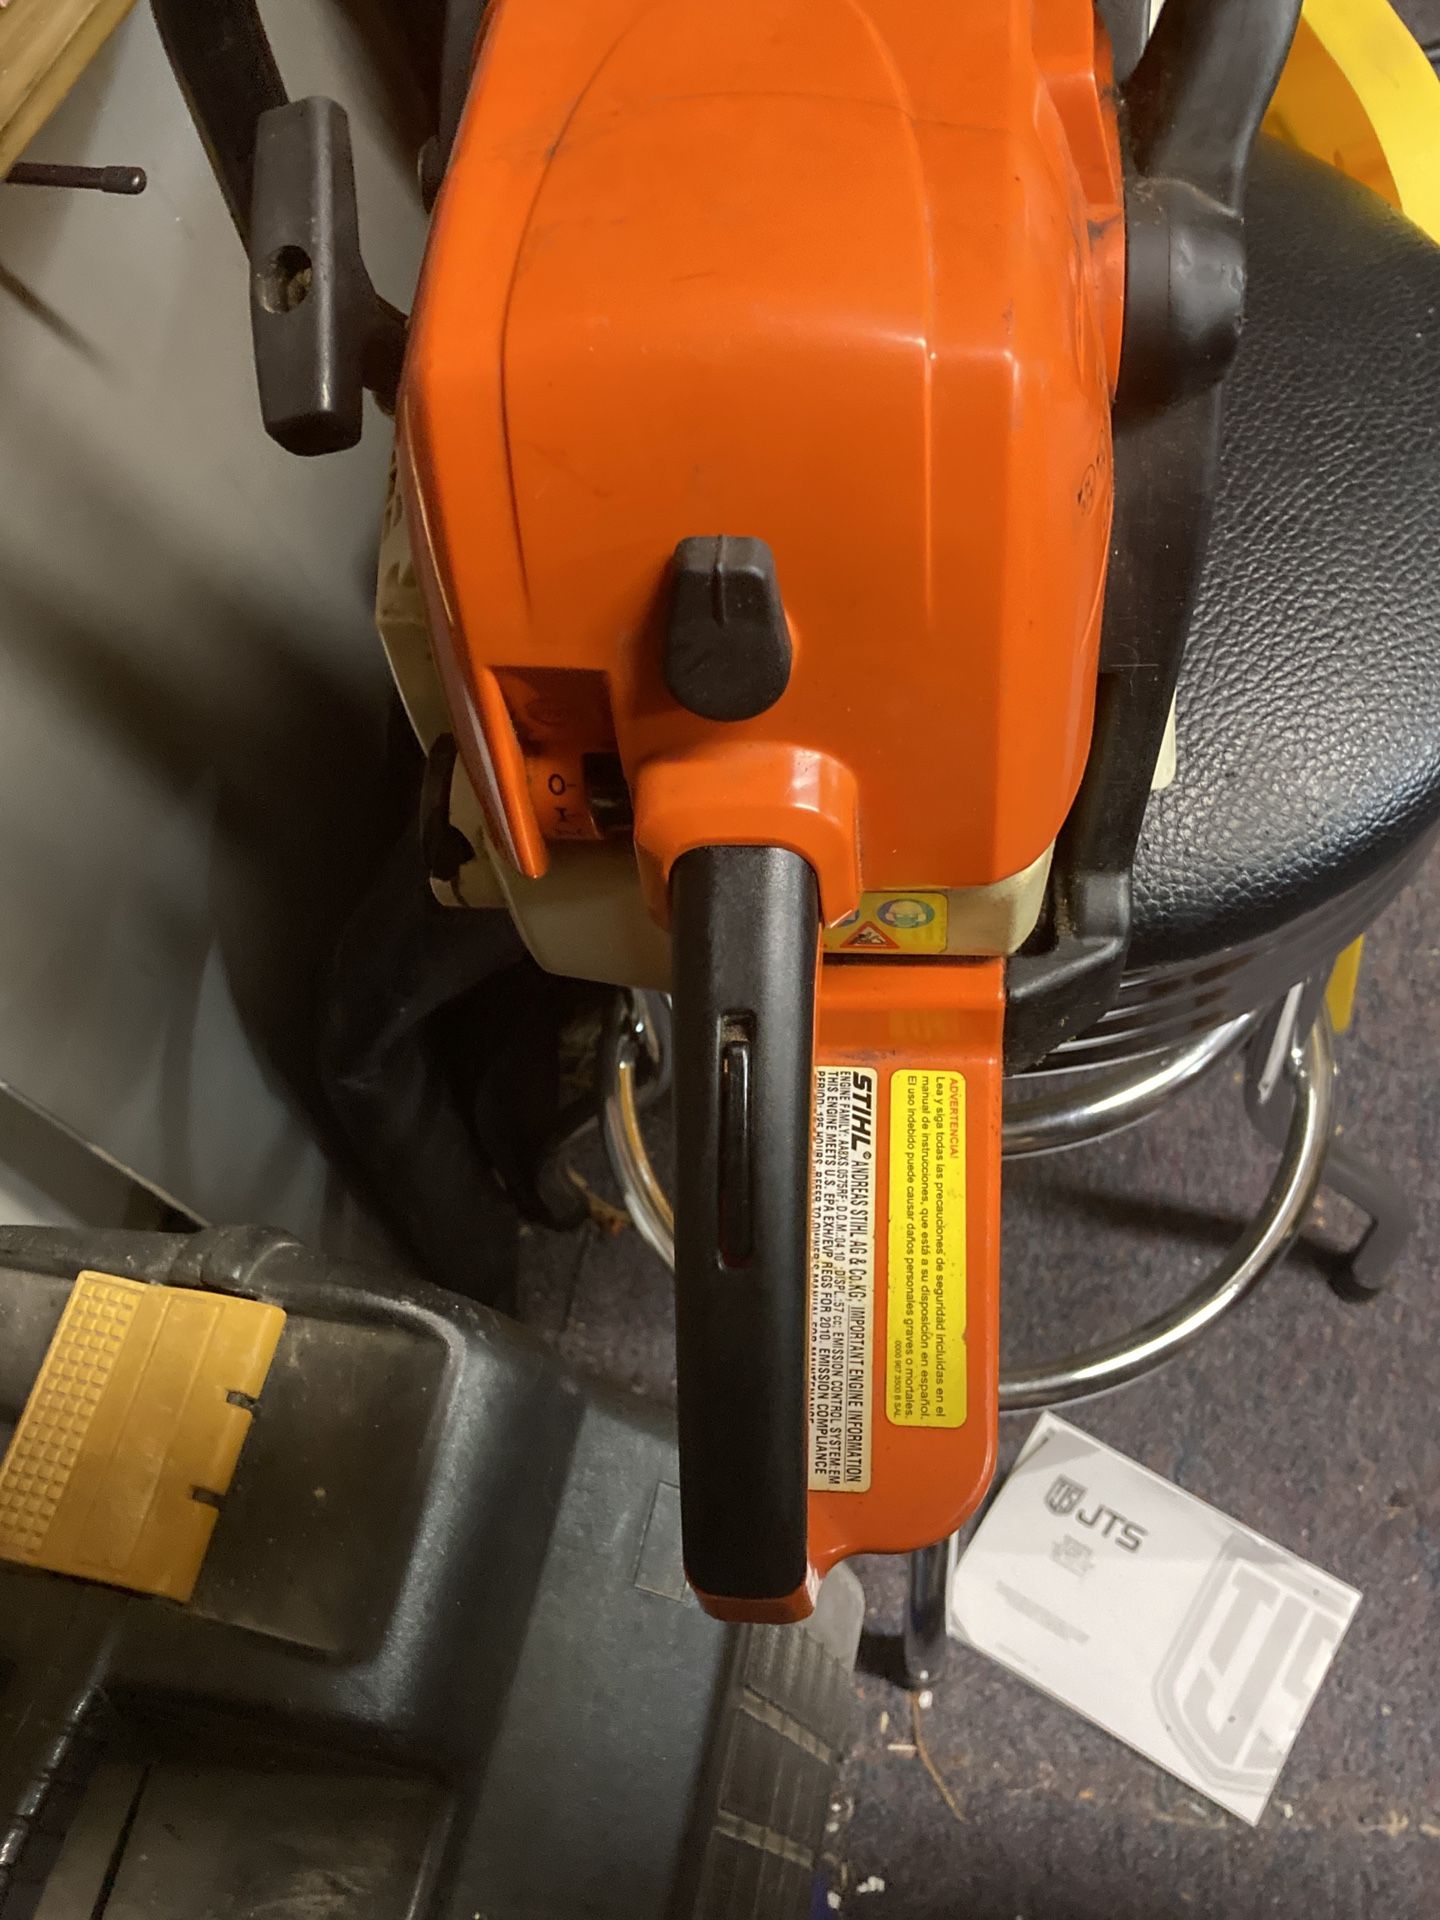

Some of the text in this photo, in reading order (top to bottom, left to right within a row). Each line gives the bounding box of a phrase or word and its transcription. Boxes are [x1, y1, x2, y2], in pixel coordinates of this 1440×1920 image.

[827, 1071, 838, 1092] THIS
[840, 1071, 851, 1100] ENGINE
[936, 1076, 946, 1096] Lea
[826, 1096, 838, 1130] ENGINE
[839, 1104, 850, 1136] FAMILY:
[851, 1071, 872, 1151] STIHL
[934, 1107, 946, 1130] siga
[950, 1078, 958, 1158] ADVERTENCIA!
[824, 1134, 836, 1166] MEETS
[936, 1132, 946, 1160] todas
[824, 1170, 836, 1189] U.S.
[850, 1160, 869, 1206] ANDREAS
[936, 1164, 946, 1180] las
[823, 1193, 834, 1212] EPA
[934, 1182, 946, 1254] precauciones
[822, 1216, 834, 1258] EXH/EVP
[850, 1210, 868, 1236] STIHL
[849, 1240, 867, 1254] AG
[903, 1076, 917, 1418] El uso indebido puede causar daños personales graves o mortales.
[918, 1076, 930, 1420] manual de instrucciones, que está a su disposición en español.
[821, 1262, 833, 1288] REGS
[936, 1257, 946, 1272] de
[820, 1292, 832, 1312] FOR
[934, 1274, 946, 1330] seguridad
[819, 1316, 831, 1344] 2010.
[849, 1306, 865, 1366] IMPORTANT
[832, 1332, 844, 1376] EMISSION
[936, 1334, 946, 1384] incluidas
[818, 1348, 830, 1399] EMISSION
[848, 1368, 864, 1406] ENGINE
[830, 1380, 843, 1424] CONTROL
[936, 1388, 944, 1403] en
[936, 1406, 946, 1417] el
[815, 1404, 829, 1474] COMPLIANCE
[846, 1410, 862, 1482] INFORMATION
[1075, 1504, 1148, 1553] JTS
